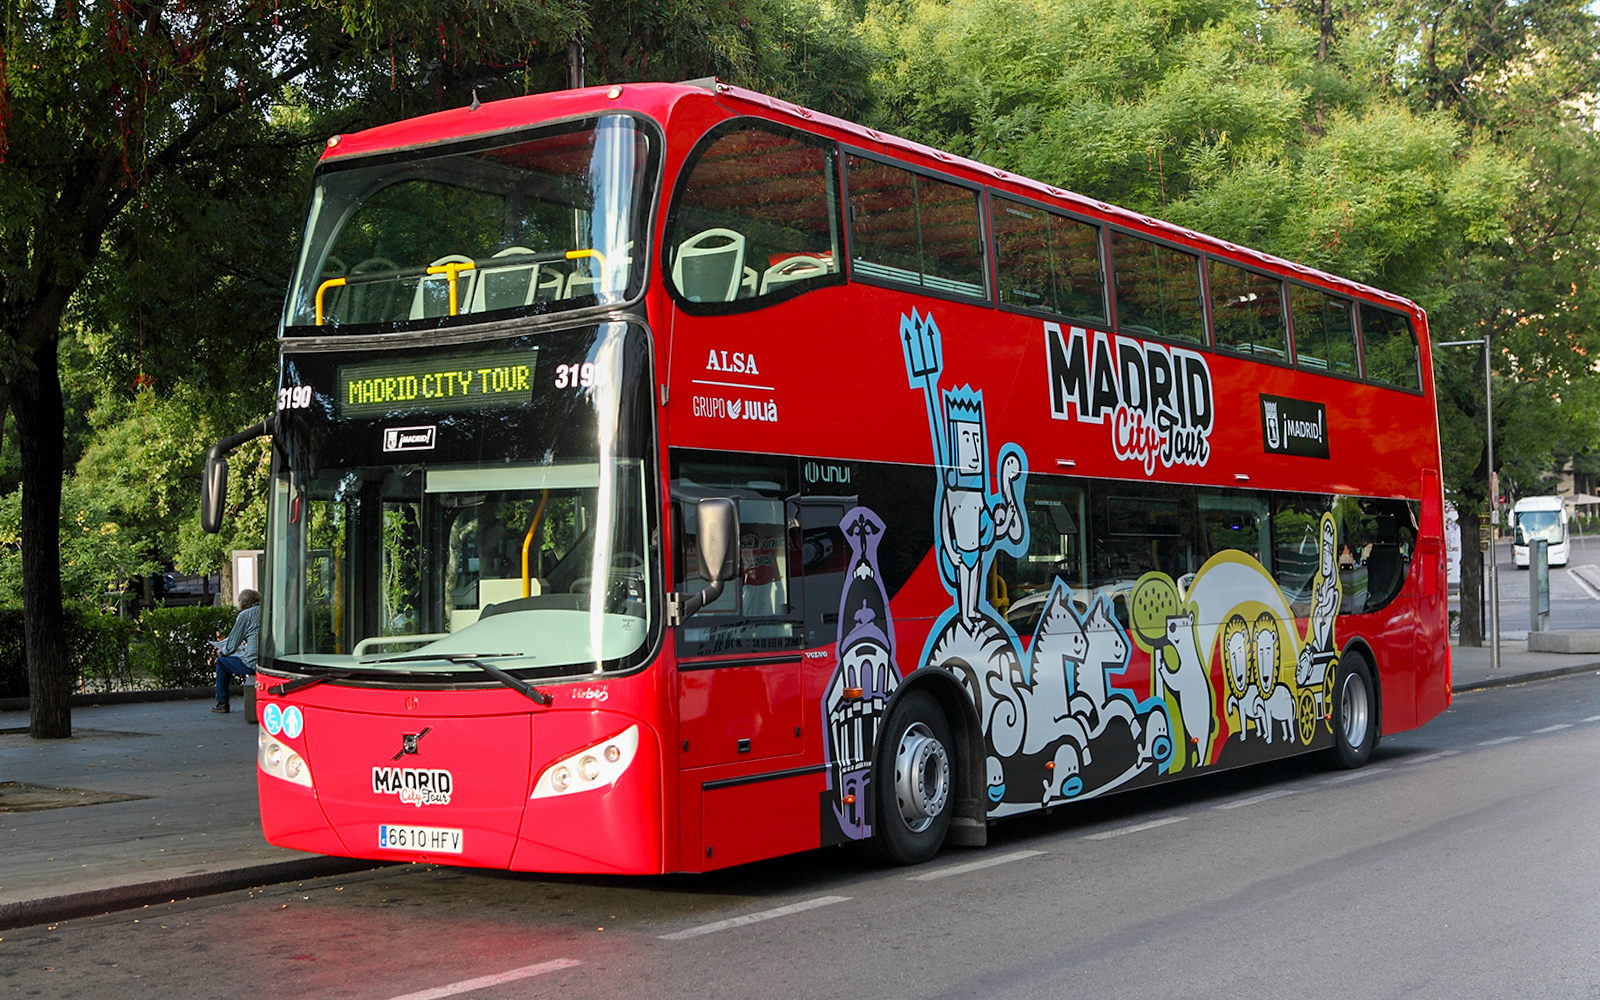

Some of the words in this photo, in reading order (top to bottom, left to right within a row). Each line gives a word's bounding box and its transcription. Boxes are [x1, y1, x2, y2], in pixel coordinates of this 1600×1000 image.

[706, 349, 759, 375] ALSA
[348, 374, 419, 405] MADRID
[421, 370, 473, 399] CITY
[477, 364, 530, 394] TOUR
[1044, 322, 1213, 436] MADRID
[279, 385, 312, 410] 3190
[692, 395, 726, 419] GRUPO
[1112, 403, 1160, 475] City
[1155, 406, 1210, 467] Tour
[804, 650, 828, 659] VOLVO
[373, 768, 451, 794] MADRID
[401, 788, 421, 805] City
[421, 788, 449, 803] Tour
[389, 828, 426, 848] 6610
[431, 830, 459, 850] HFV
